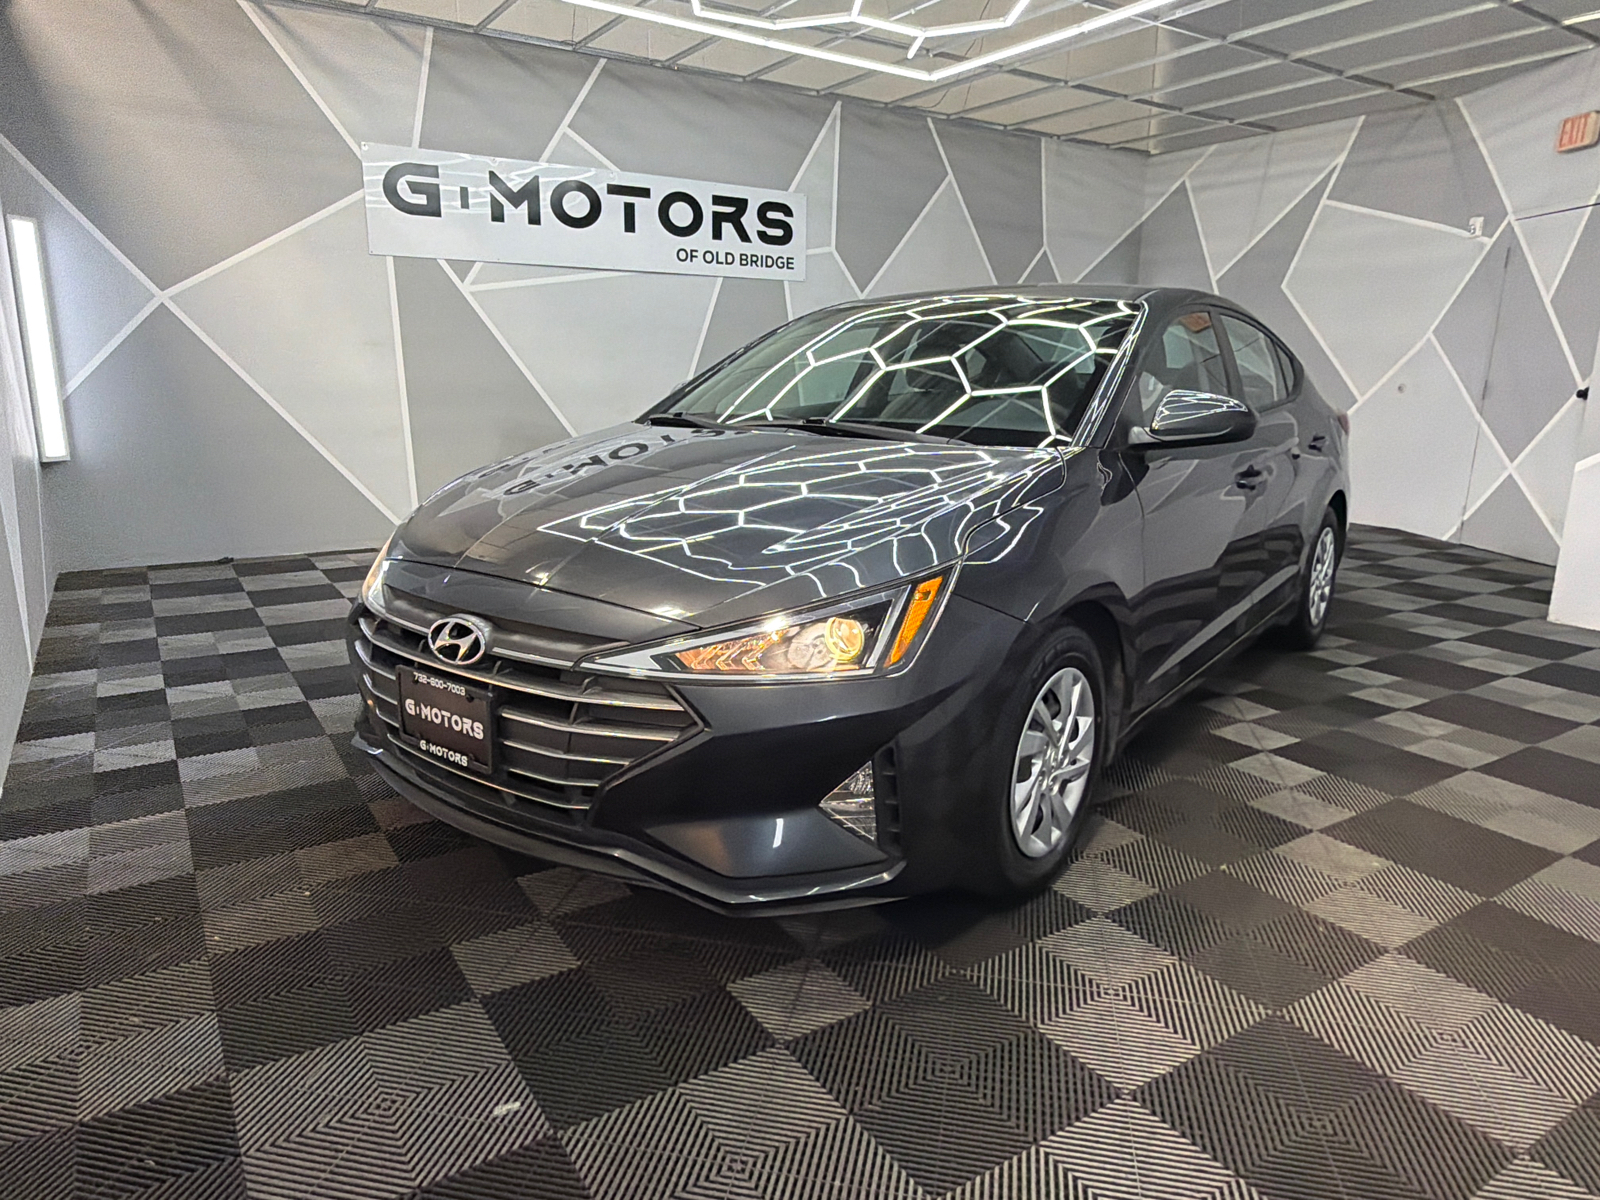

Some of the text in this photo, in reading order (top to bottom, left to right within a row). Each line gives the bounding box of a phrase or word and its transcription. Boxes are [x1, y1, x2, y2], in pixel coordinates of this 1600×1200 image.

[676, 248, 795, 271] OF OLD BRIDGE
